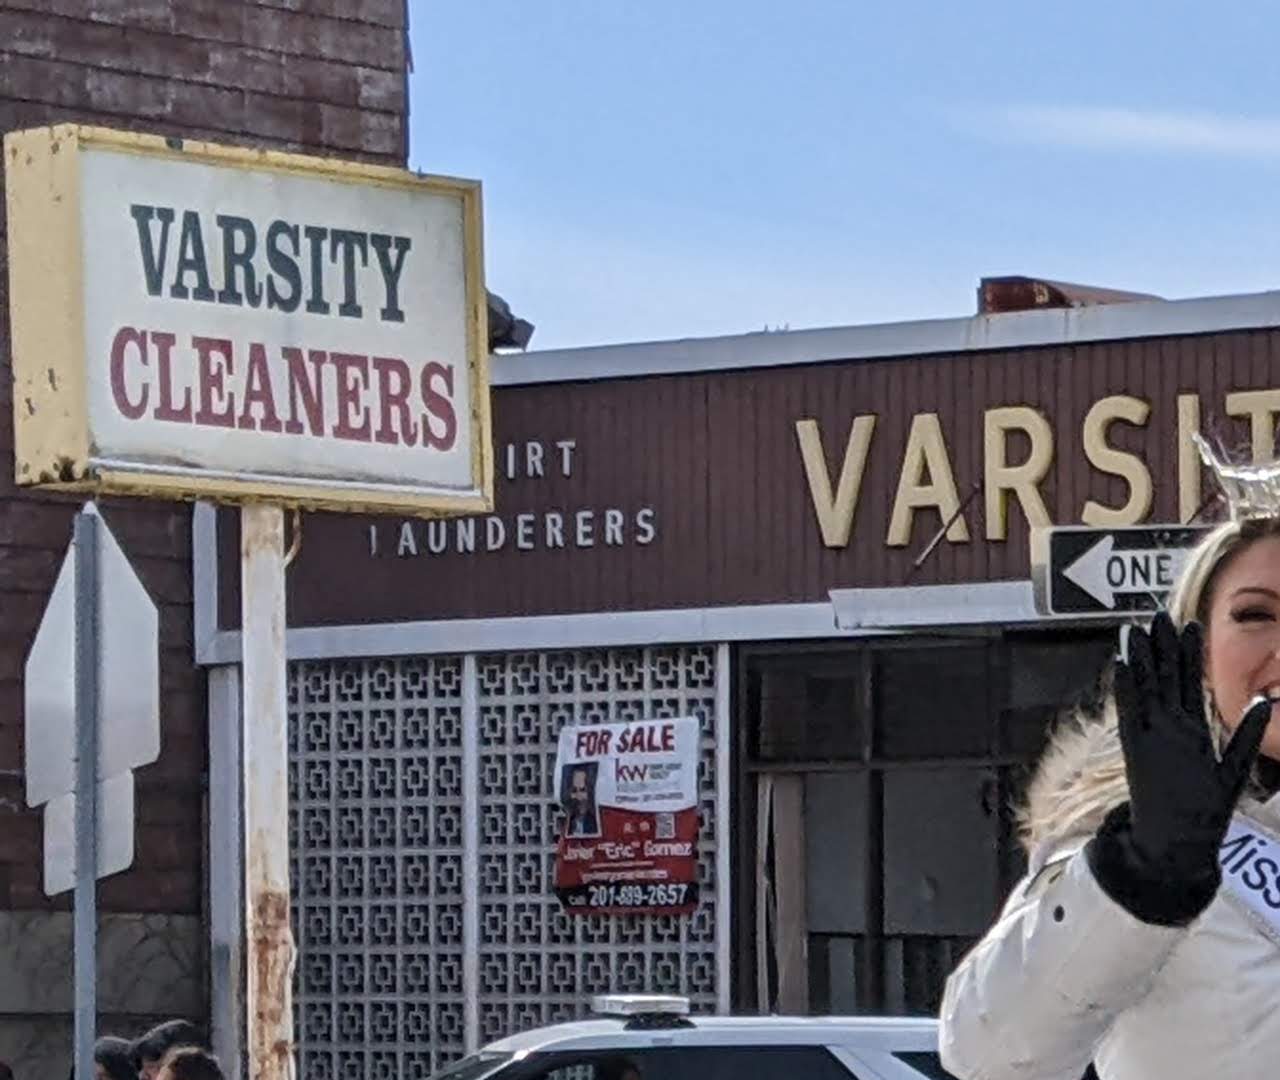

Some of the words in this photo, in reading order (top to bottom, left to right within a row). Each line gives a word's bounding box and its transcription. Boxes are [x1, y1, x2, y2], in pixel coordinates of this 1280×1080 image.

[131, 204, 411, 323] VARSITY
[109, 326, 457, 452] CLEANERS
[507, 440, 576, 479] IRT
[1106, 554, 1174, 588] ONE
[575, 729, 613, 759] FOR
[615, 725, 675, 753] SALE
